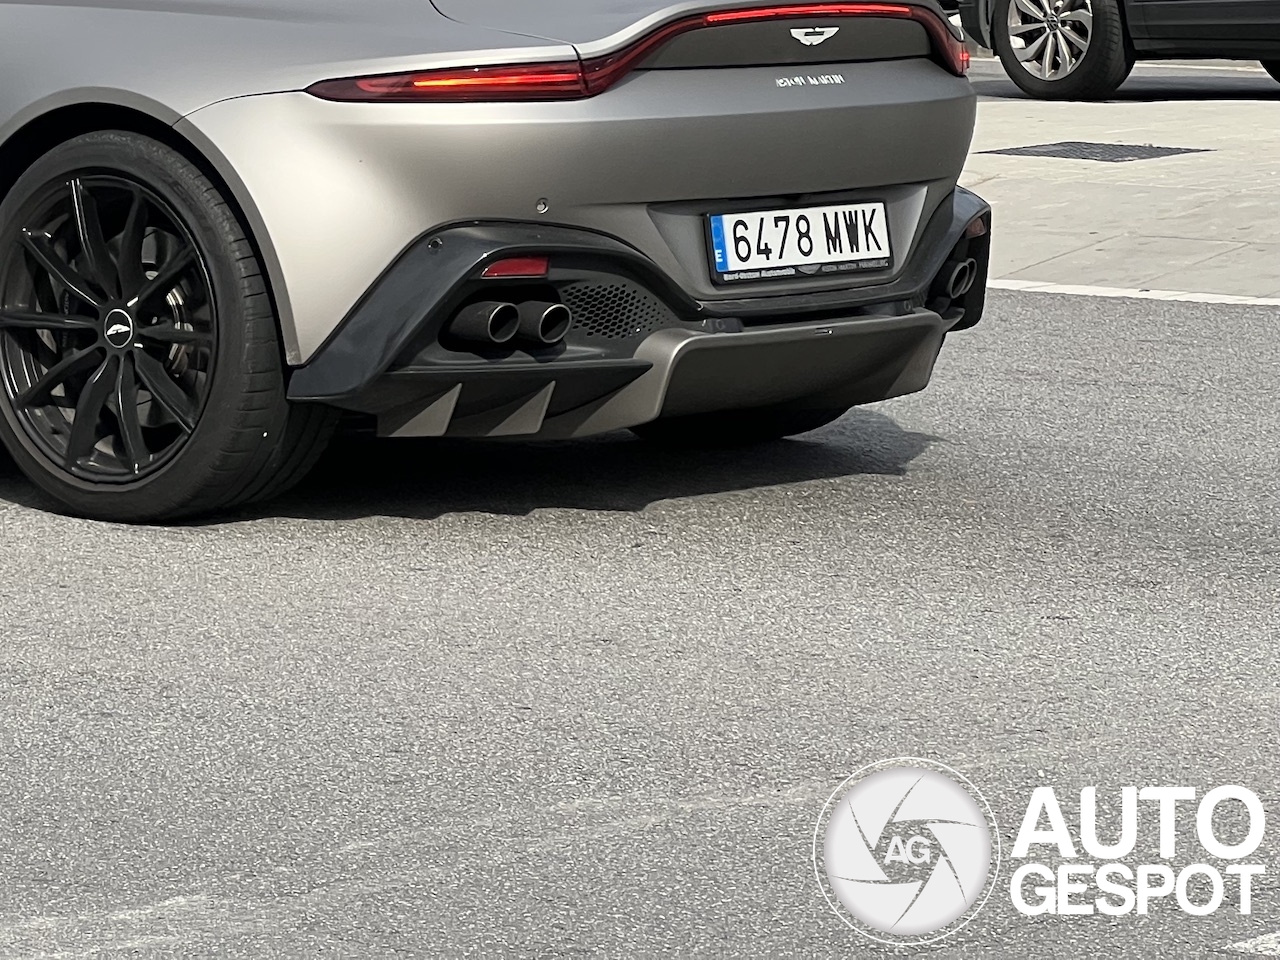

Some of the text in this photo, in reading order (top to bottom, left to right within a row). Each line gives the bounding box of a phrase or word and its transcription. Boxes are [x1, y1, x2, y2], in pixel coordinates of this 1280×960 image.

[714, 208, 882, 263] E 6478 MWK
